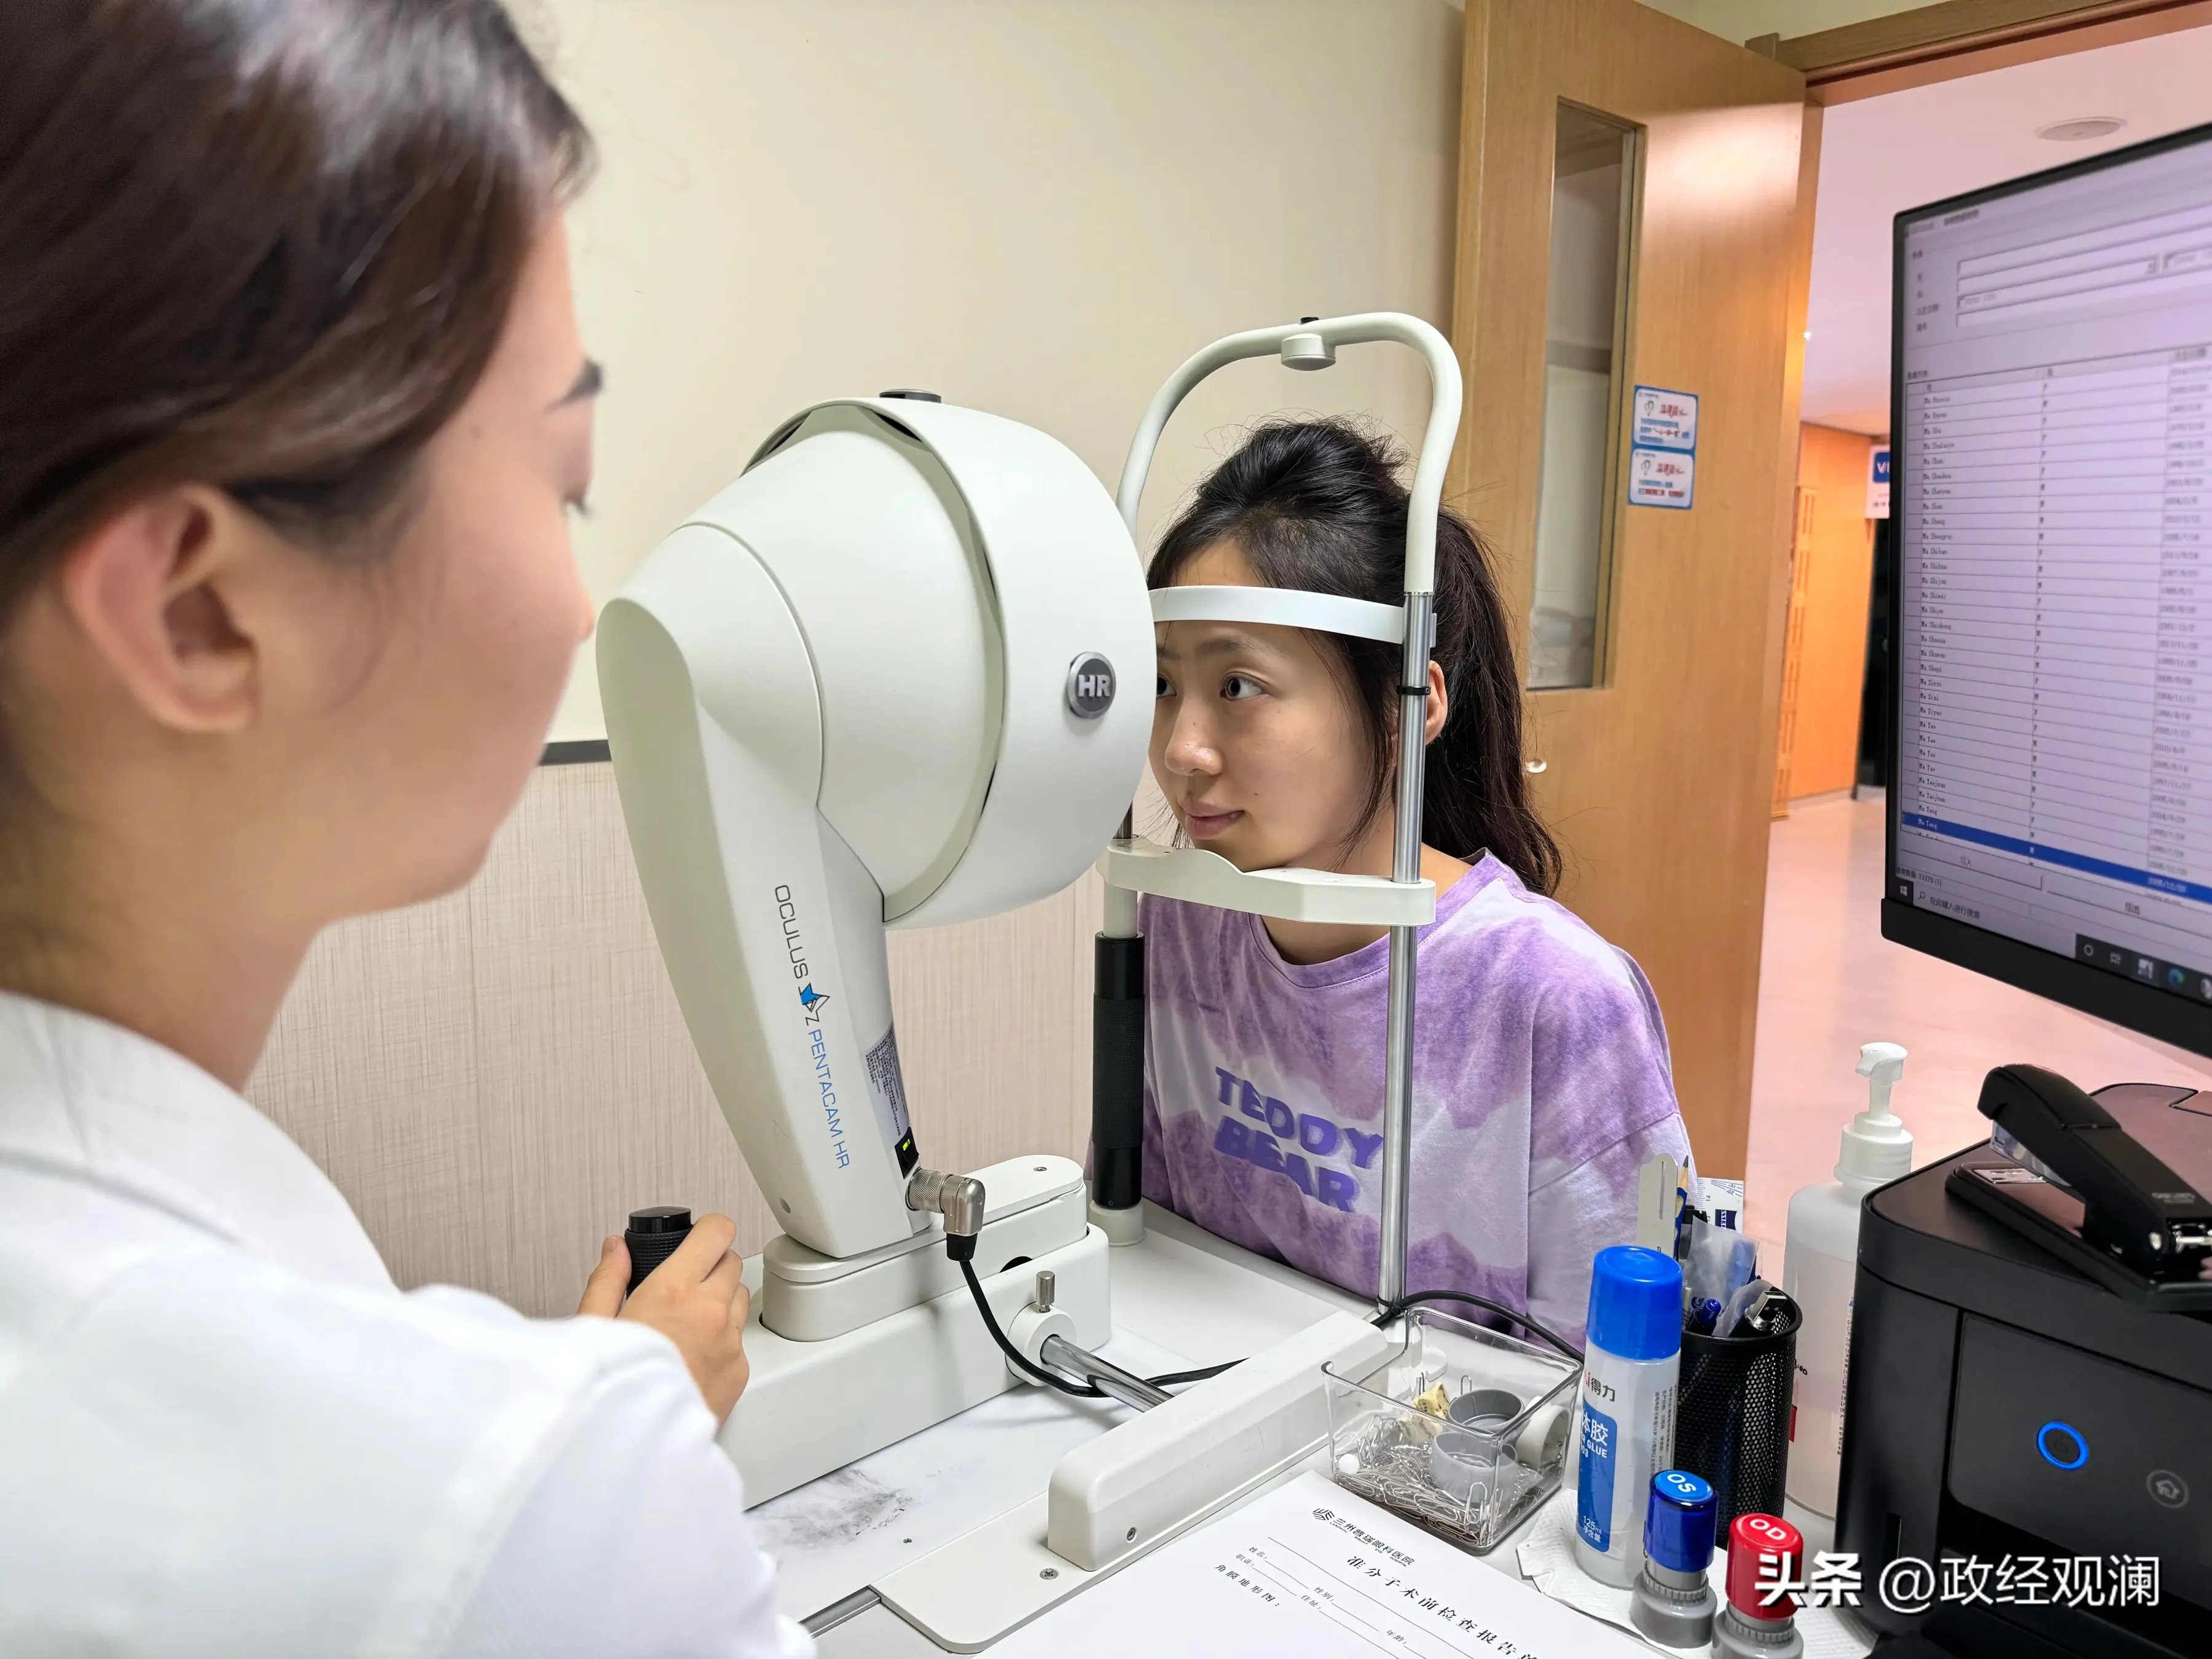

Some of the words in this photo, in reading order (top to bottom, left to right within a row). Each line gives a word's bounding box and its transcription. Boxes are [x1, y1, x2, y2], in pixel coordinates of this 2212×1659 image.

[1078, 674, 1111, 697] HR
[775, 885, 809, 979] OCULUS
[809, 1029, 844, 1139] PENTACAM
[833, 1141, 850, 1169] HR
[1215, 1066, 1384, 1169] TEDDY
[1214, 1115, 1359, 1213] BEAR
[1591, 1377, 1615, 1402] 得力
[1586, 1439, 1607, 1459] GLUE
[1666, 1473, 1697, 1493] OS
[1583, 1515, 1602, 1534] 125ml
[1749, 1518, 1787, 1540] OD
[1332, 1518, 1415, 1566] 兰州普瑞眼科医院
